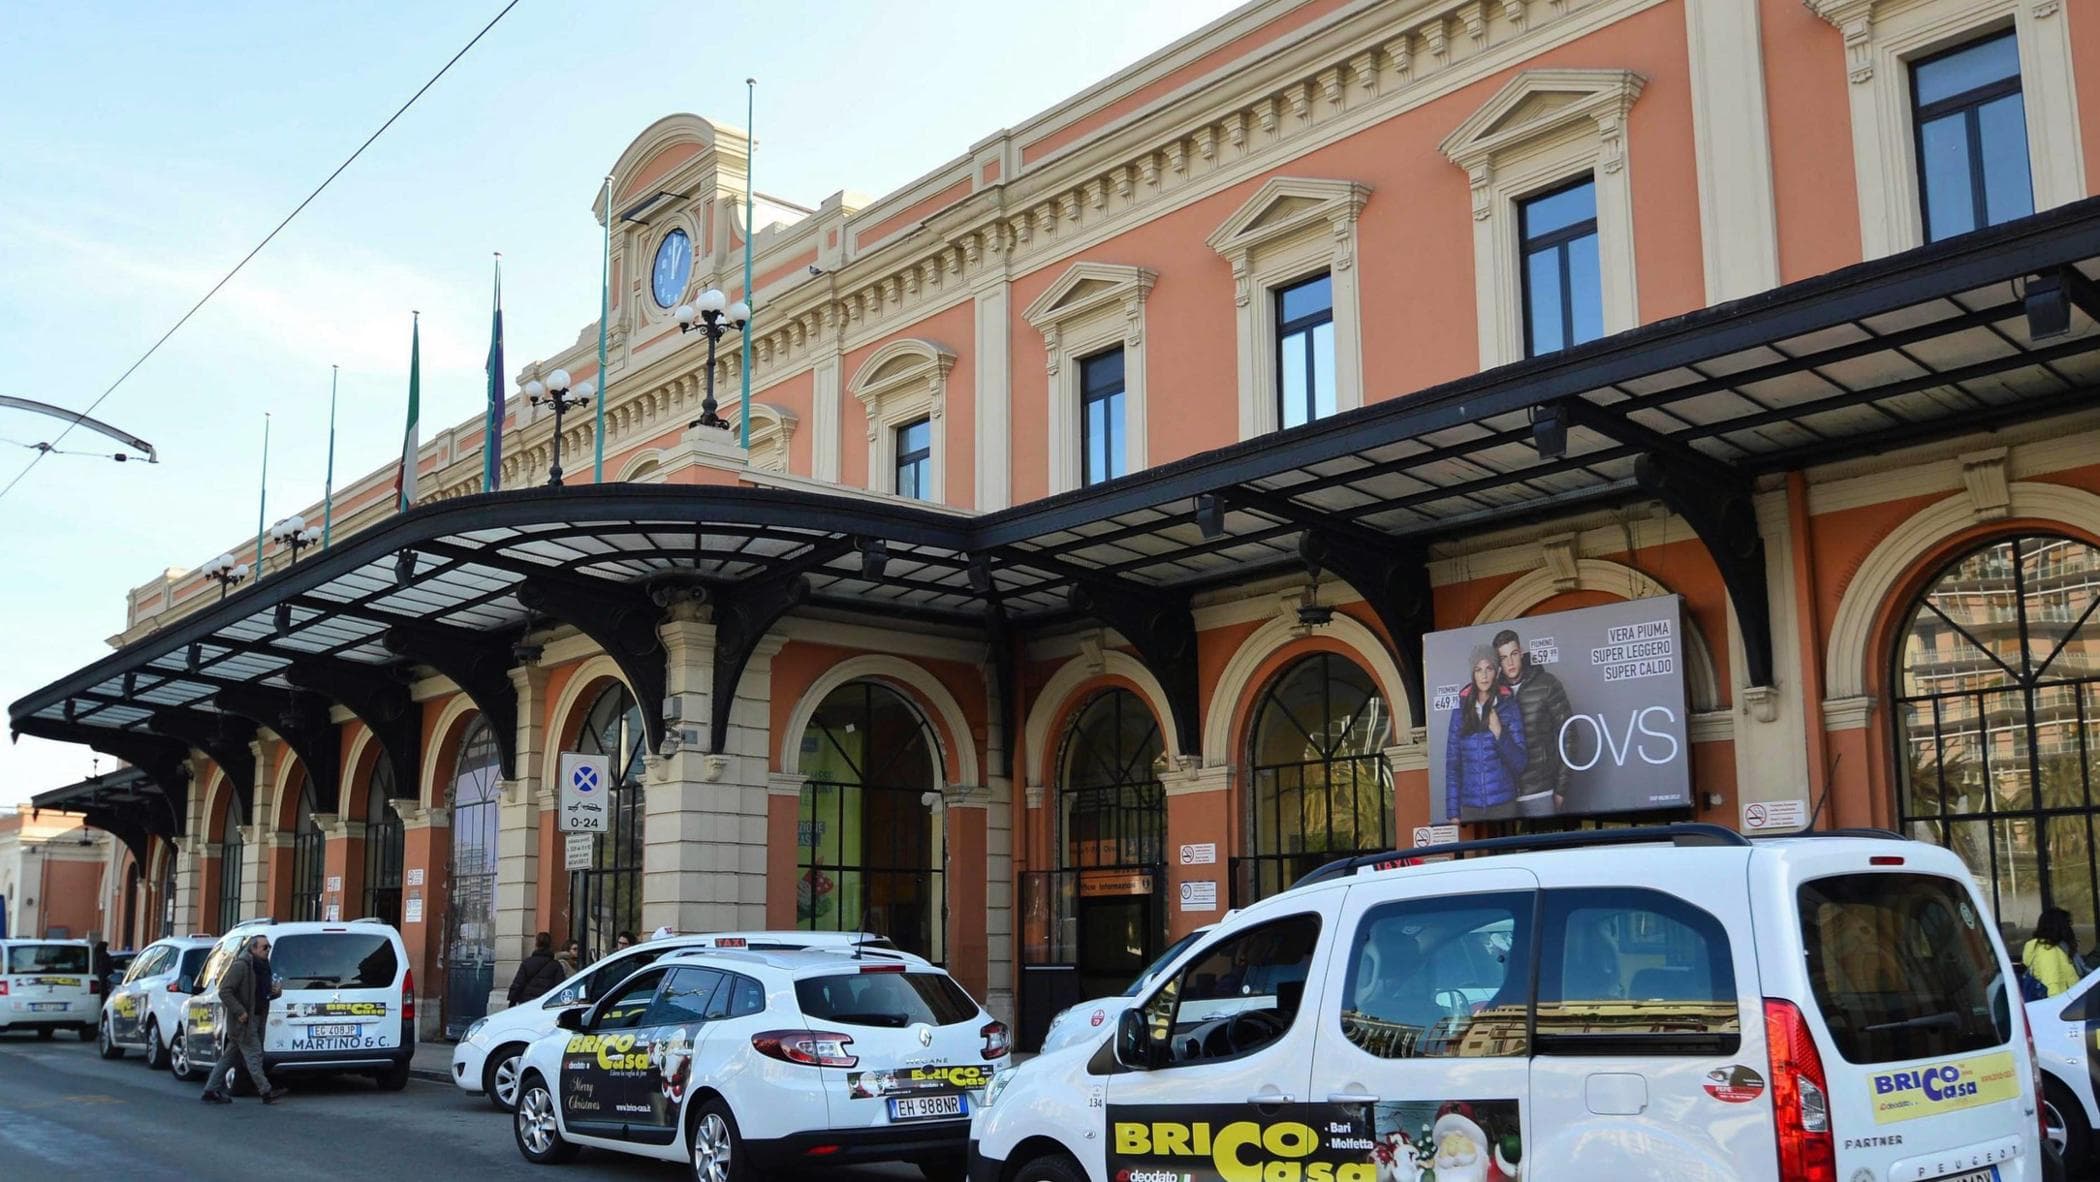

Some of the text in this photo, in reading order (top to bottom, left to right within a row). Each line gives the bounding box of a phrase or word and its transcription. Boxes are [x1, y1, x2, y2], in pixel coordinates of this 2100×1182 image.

[1610, 622, 1669, 642] VERA PIUMA
[1592, 640, 1671, 663] SUPER LEGGERO
[1605, 659, 1672, 680] SUPER CALDO
[1558, 705, 1678, 771] OVS
[570, 817, 598, 828] 0-24
[718, 938, 745, 947] TAXI
[292, 1036, 390, 1050] MARTINO & C.
[566, 1034, 636, 1066] BRICO
[911, 1067, 980, 1085] BRICO
[1874, 1066, 1960, 1100] BRICO
[899, 1097, 959, 1116] EH 988NR
[1089, 1097, 1102, 1108] 134
[1330, 1122, 1351, 1133] Bari
[1331, 1137, 1374, 1150] Molfetta
[1844, 1134, 1903, 1150] PARTNER
[1917, 1145, 2018, 1178] PEUGEOT
[1130, 1170, 1178, 1182] deodato
